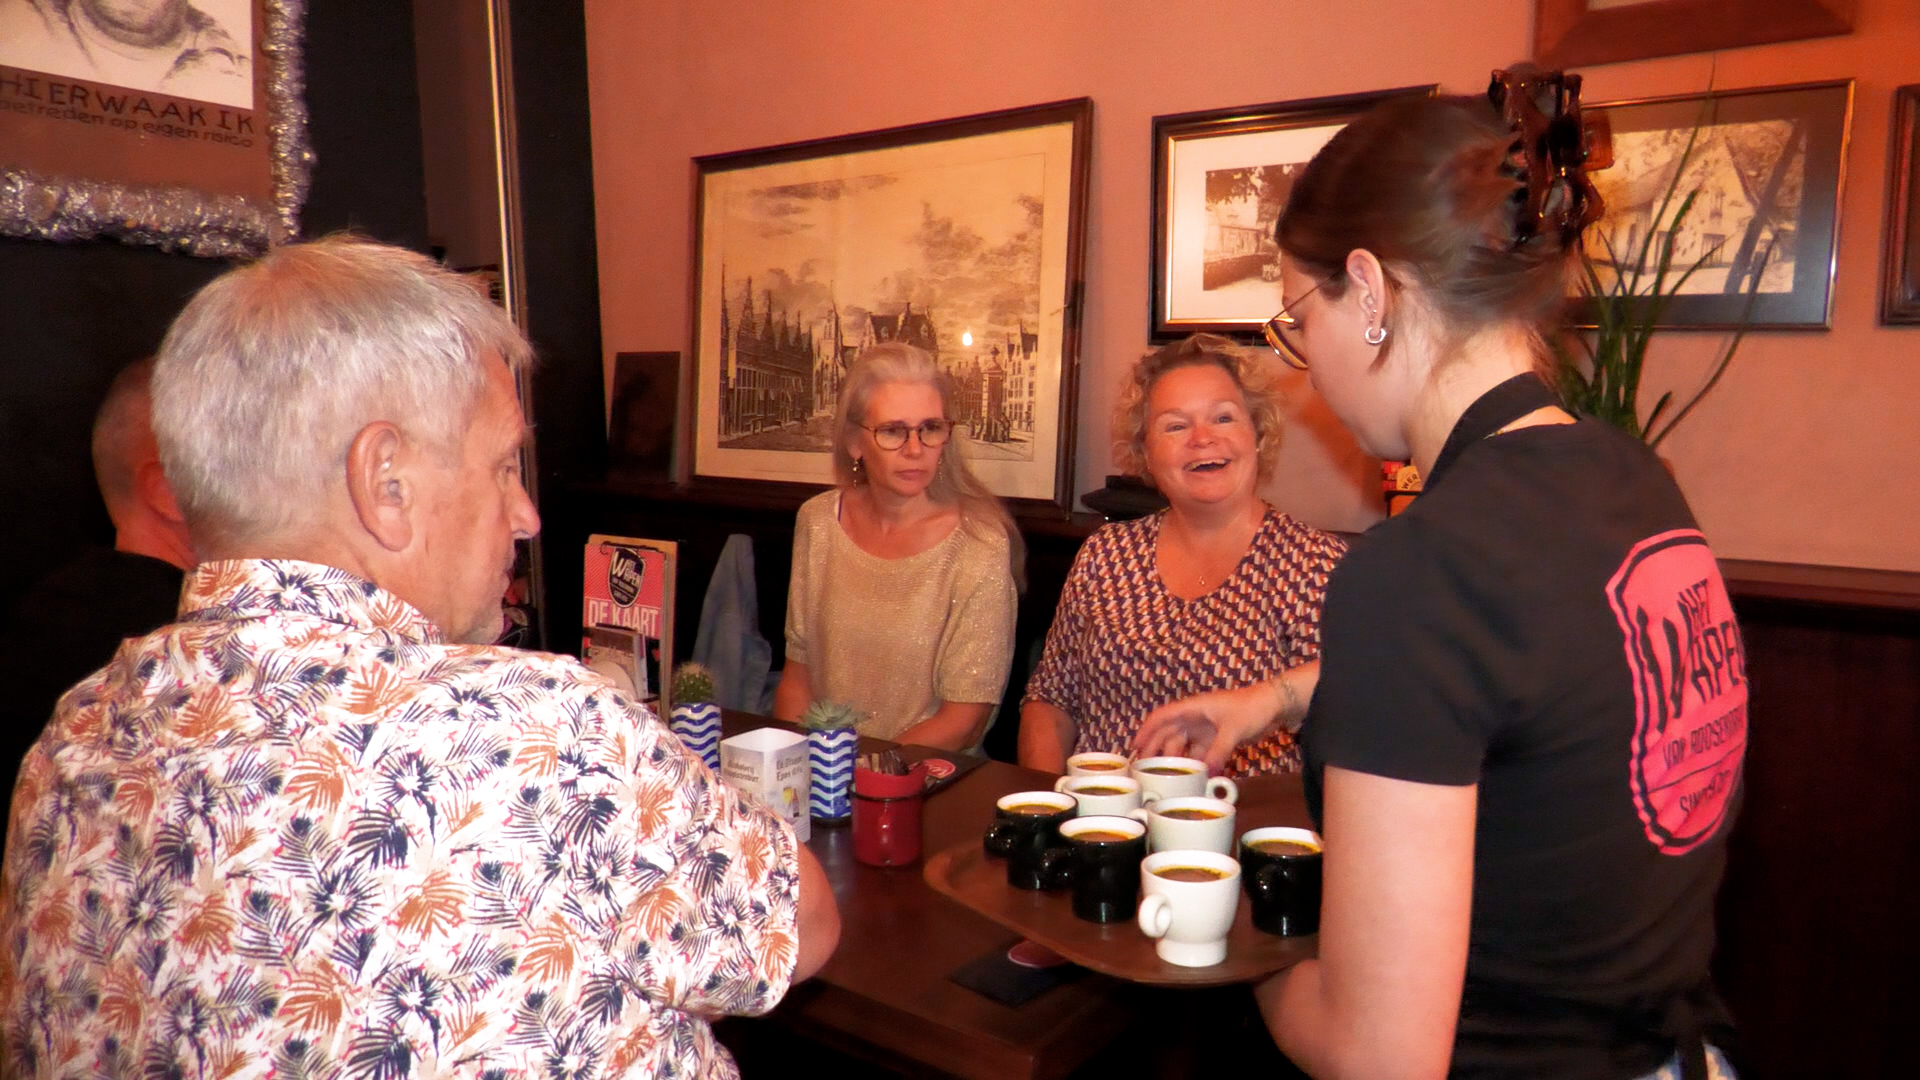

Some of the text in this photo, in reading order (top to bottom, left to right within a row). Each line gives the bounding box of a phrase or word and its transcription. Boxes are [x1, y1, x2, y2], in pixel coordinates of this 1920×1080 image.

[95, 89, 206, 126] WAAK
[217, 110, 254, 134] IK
[110, 117, 138, 131] op
[142, 121, 198, 139] eigen
[203, 130, 254, 148] risico
[612, 605, 659, 637] KAART
